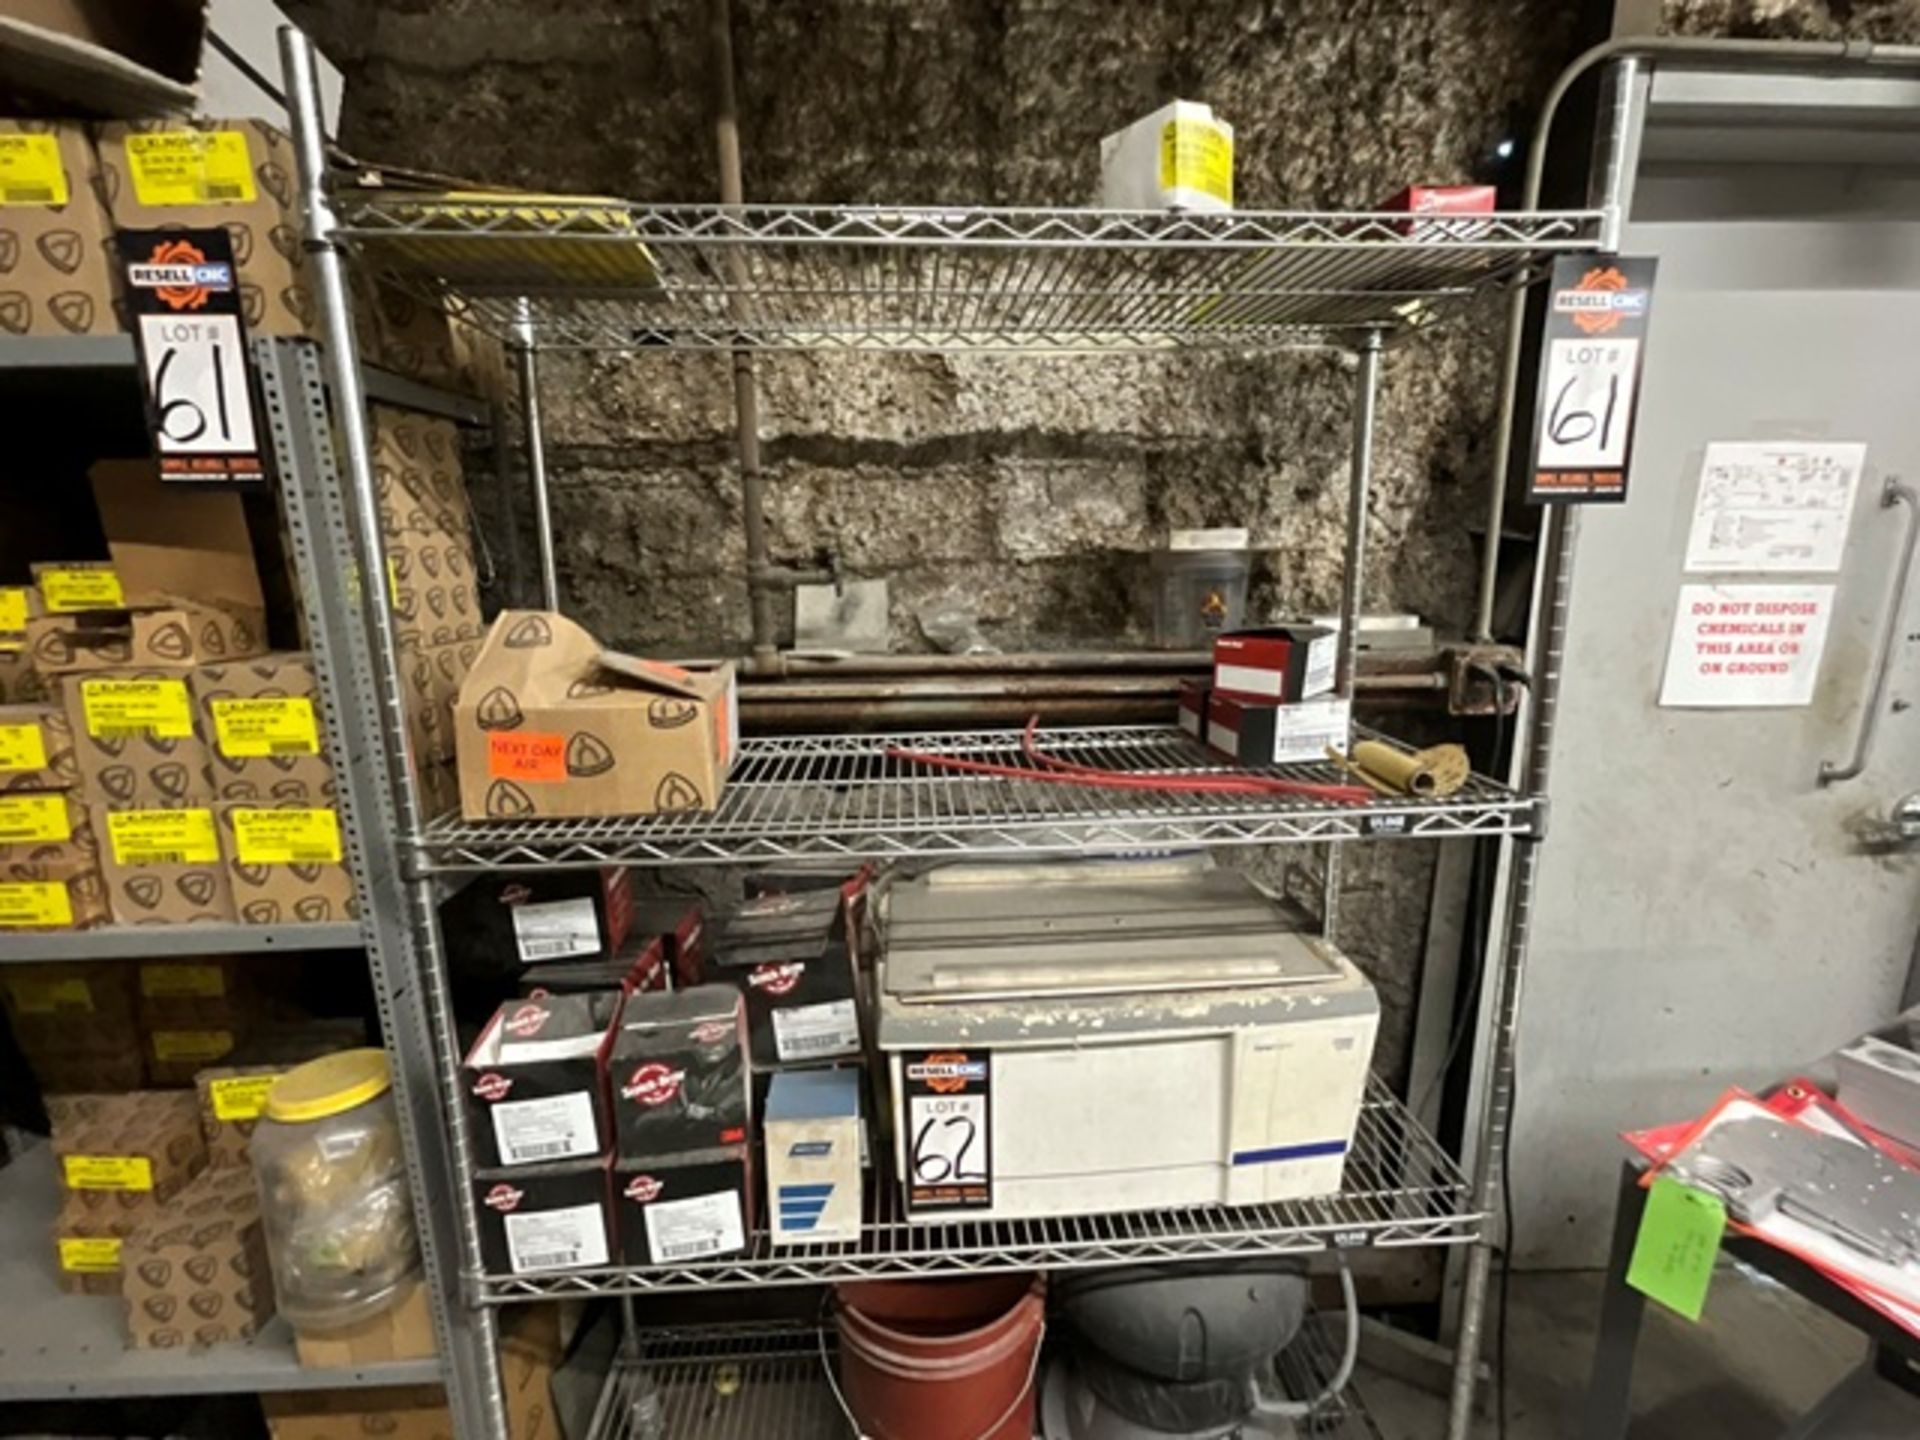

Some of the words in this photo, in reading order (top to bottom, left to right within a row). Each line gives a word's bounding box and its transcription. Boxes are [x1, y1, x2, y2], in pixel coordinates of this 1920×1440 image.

[133, 266, 191, 283] RESELL
[1558, 292, 1608, 308] RESELL
[161, 324, 201, 343] LOT
[1566, 347, 1604, 364] LOT
[1607, 348, 1620, 363] #
[153, 344, 231, 444] 61
[1548, 374, 1618, 451] 61
[1692, 602, 1715, 615] DO
[1719, 602, 1751, 615] NOT
[1755, 602, 1818, 616] DISPOSE
[1697, 622, 1785, 635] CHEMICALS
[1788, 622, 1806, 635] IN
[1696, 642, 1732, 655] THIS
[1736, 642, 1774, 655] AREA
[1779, 641, 1799, 655] OR
[1699, 662, 1722, 675] ON
[1726, 662, 1789, 675] GROUND
[492, 739, 527, 755] NEXT
[530, 743, 562, 757] DAY
[514, 757, 539, 770] AIR
[910, 1064, 955, 1076] RESELL
[925, 1101, 957, 1114] LOT
[959, 1101, 971, 1113] #
[913, 1115, 987, 1183] 62
